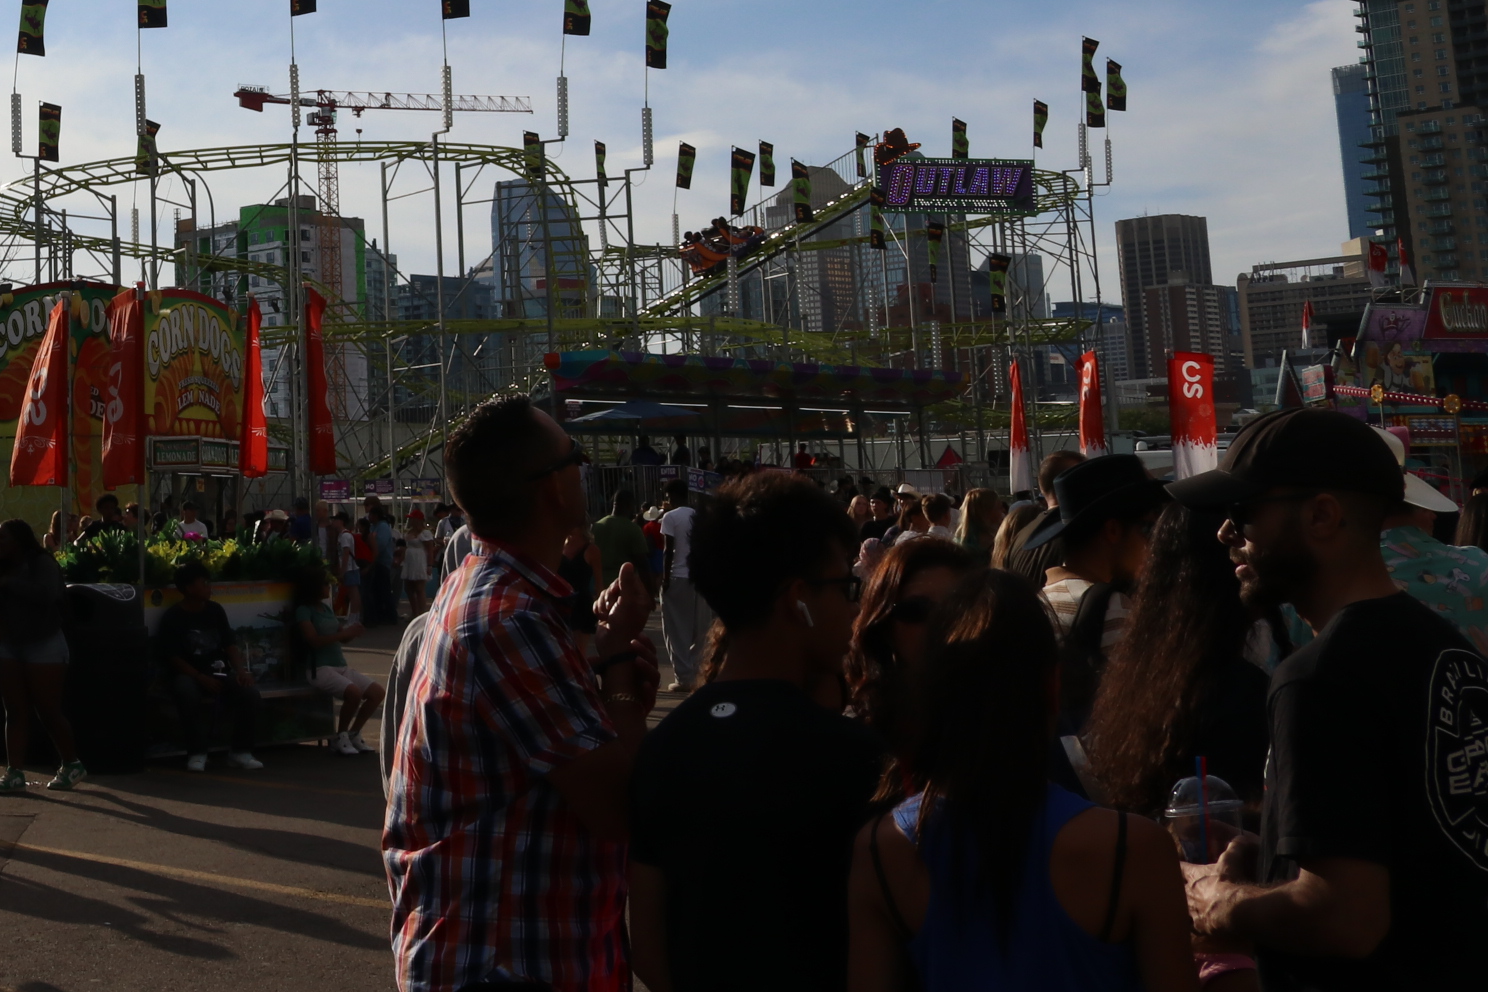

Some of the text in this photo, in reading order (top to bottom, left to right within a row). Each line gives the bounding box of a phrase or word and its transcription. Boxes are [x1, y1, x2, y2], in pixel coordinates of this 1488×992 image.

[886, 164, 1024, 206] OUTLAW
[148, 303, 195, 378] CORN
[198, 306, 242, 390] DOGS
[156, 451, 197, 462] LEMONADE
